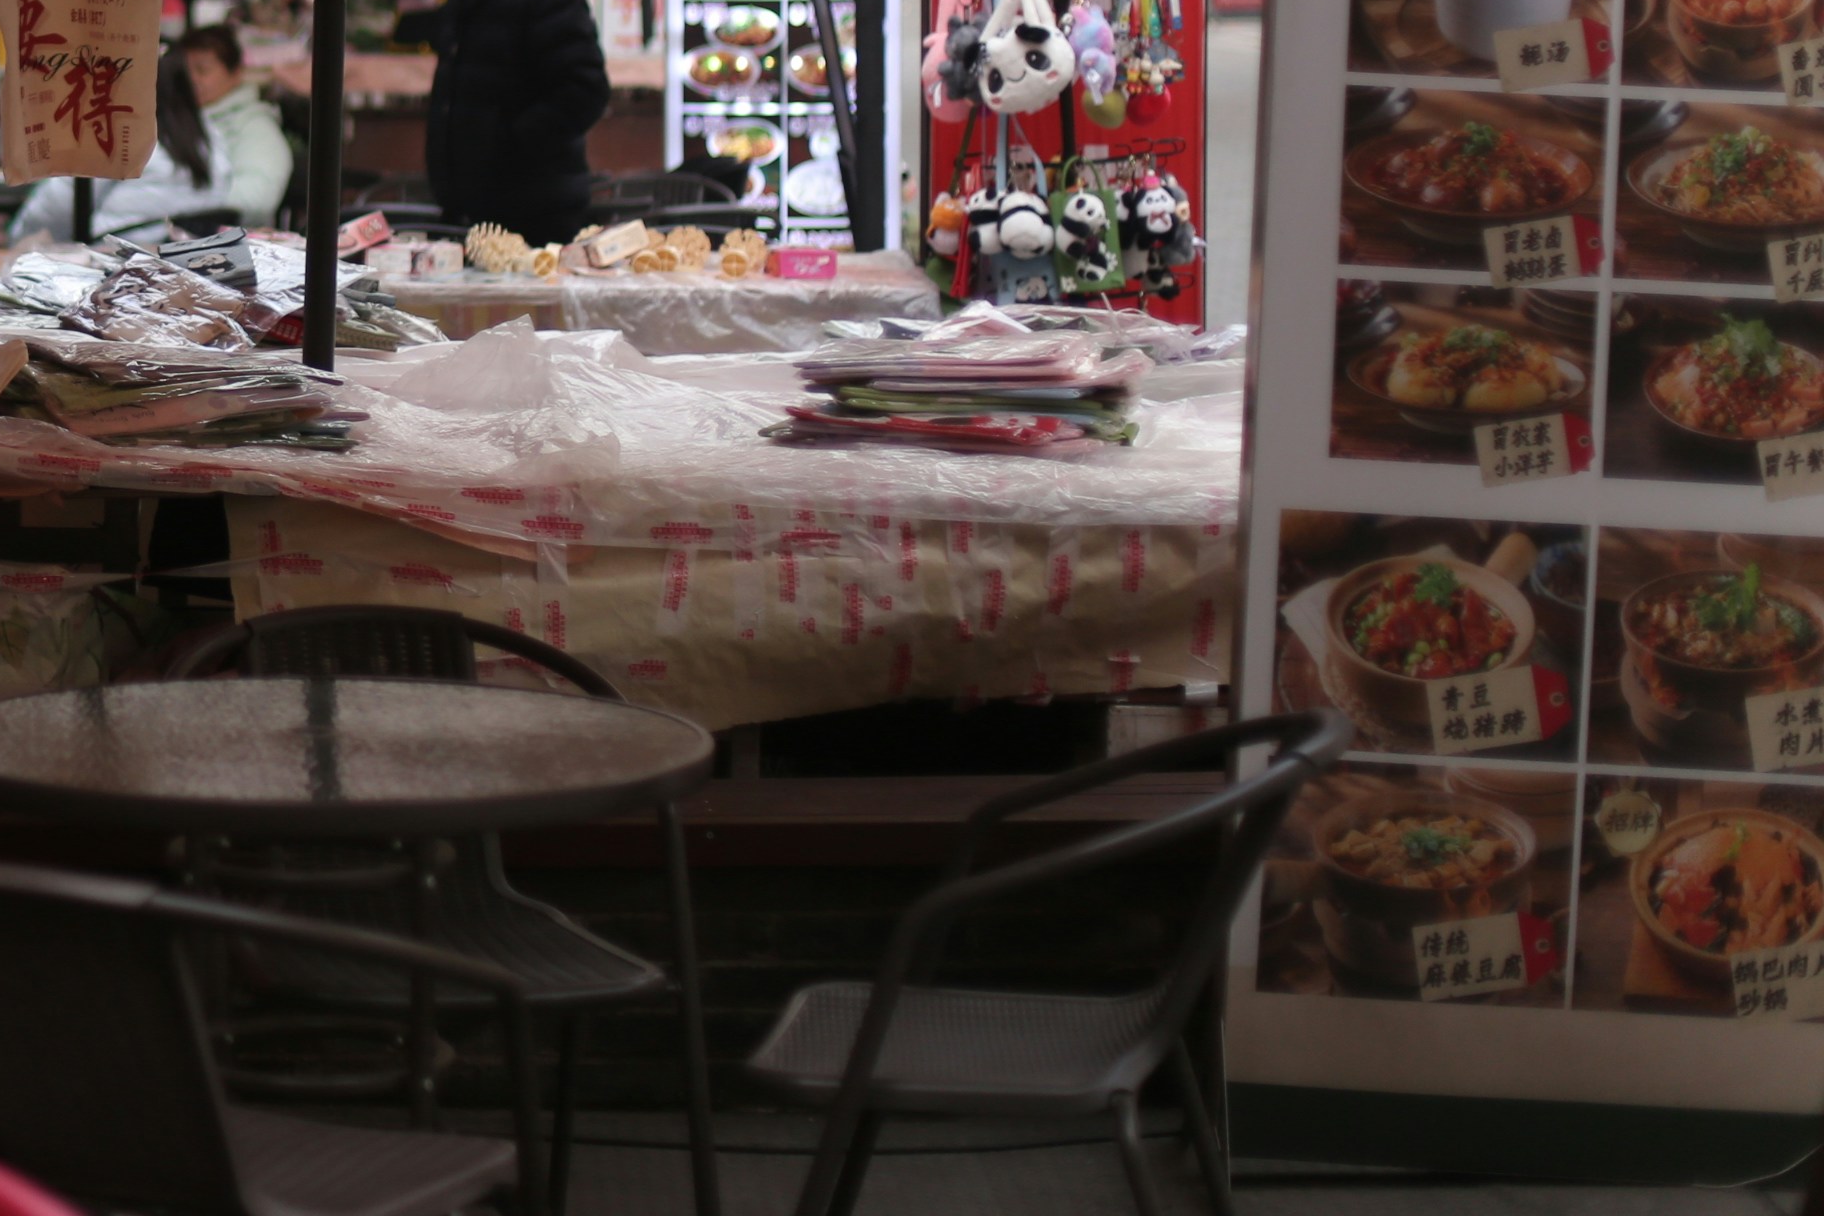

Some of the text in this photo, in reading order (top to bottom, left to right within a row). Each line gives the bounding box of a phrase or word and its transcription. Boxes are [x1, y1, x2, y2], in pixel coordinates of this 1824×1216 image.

[1440, 683, 1492, 712] 青豆
[1442, 708, 1527, 741] 烧猪蹄
[1422, 953, 1524, 989] 麻婆豆腐
